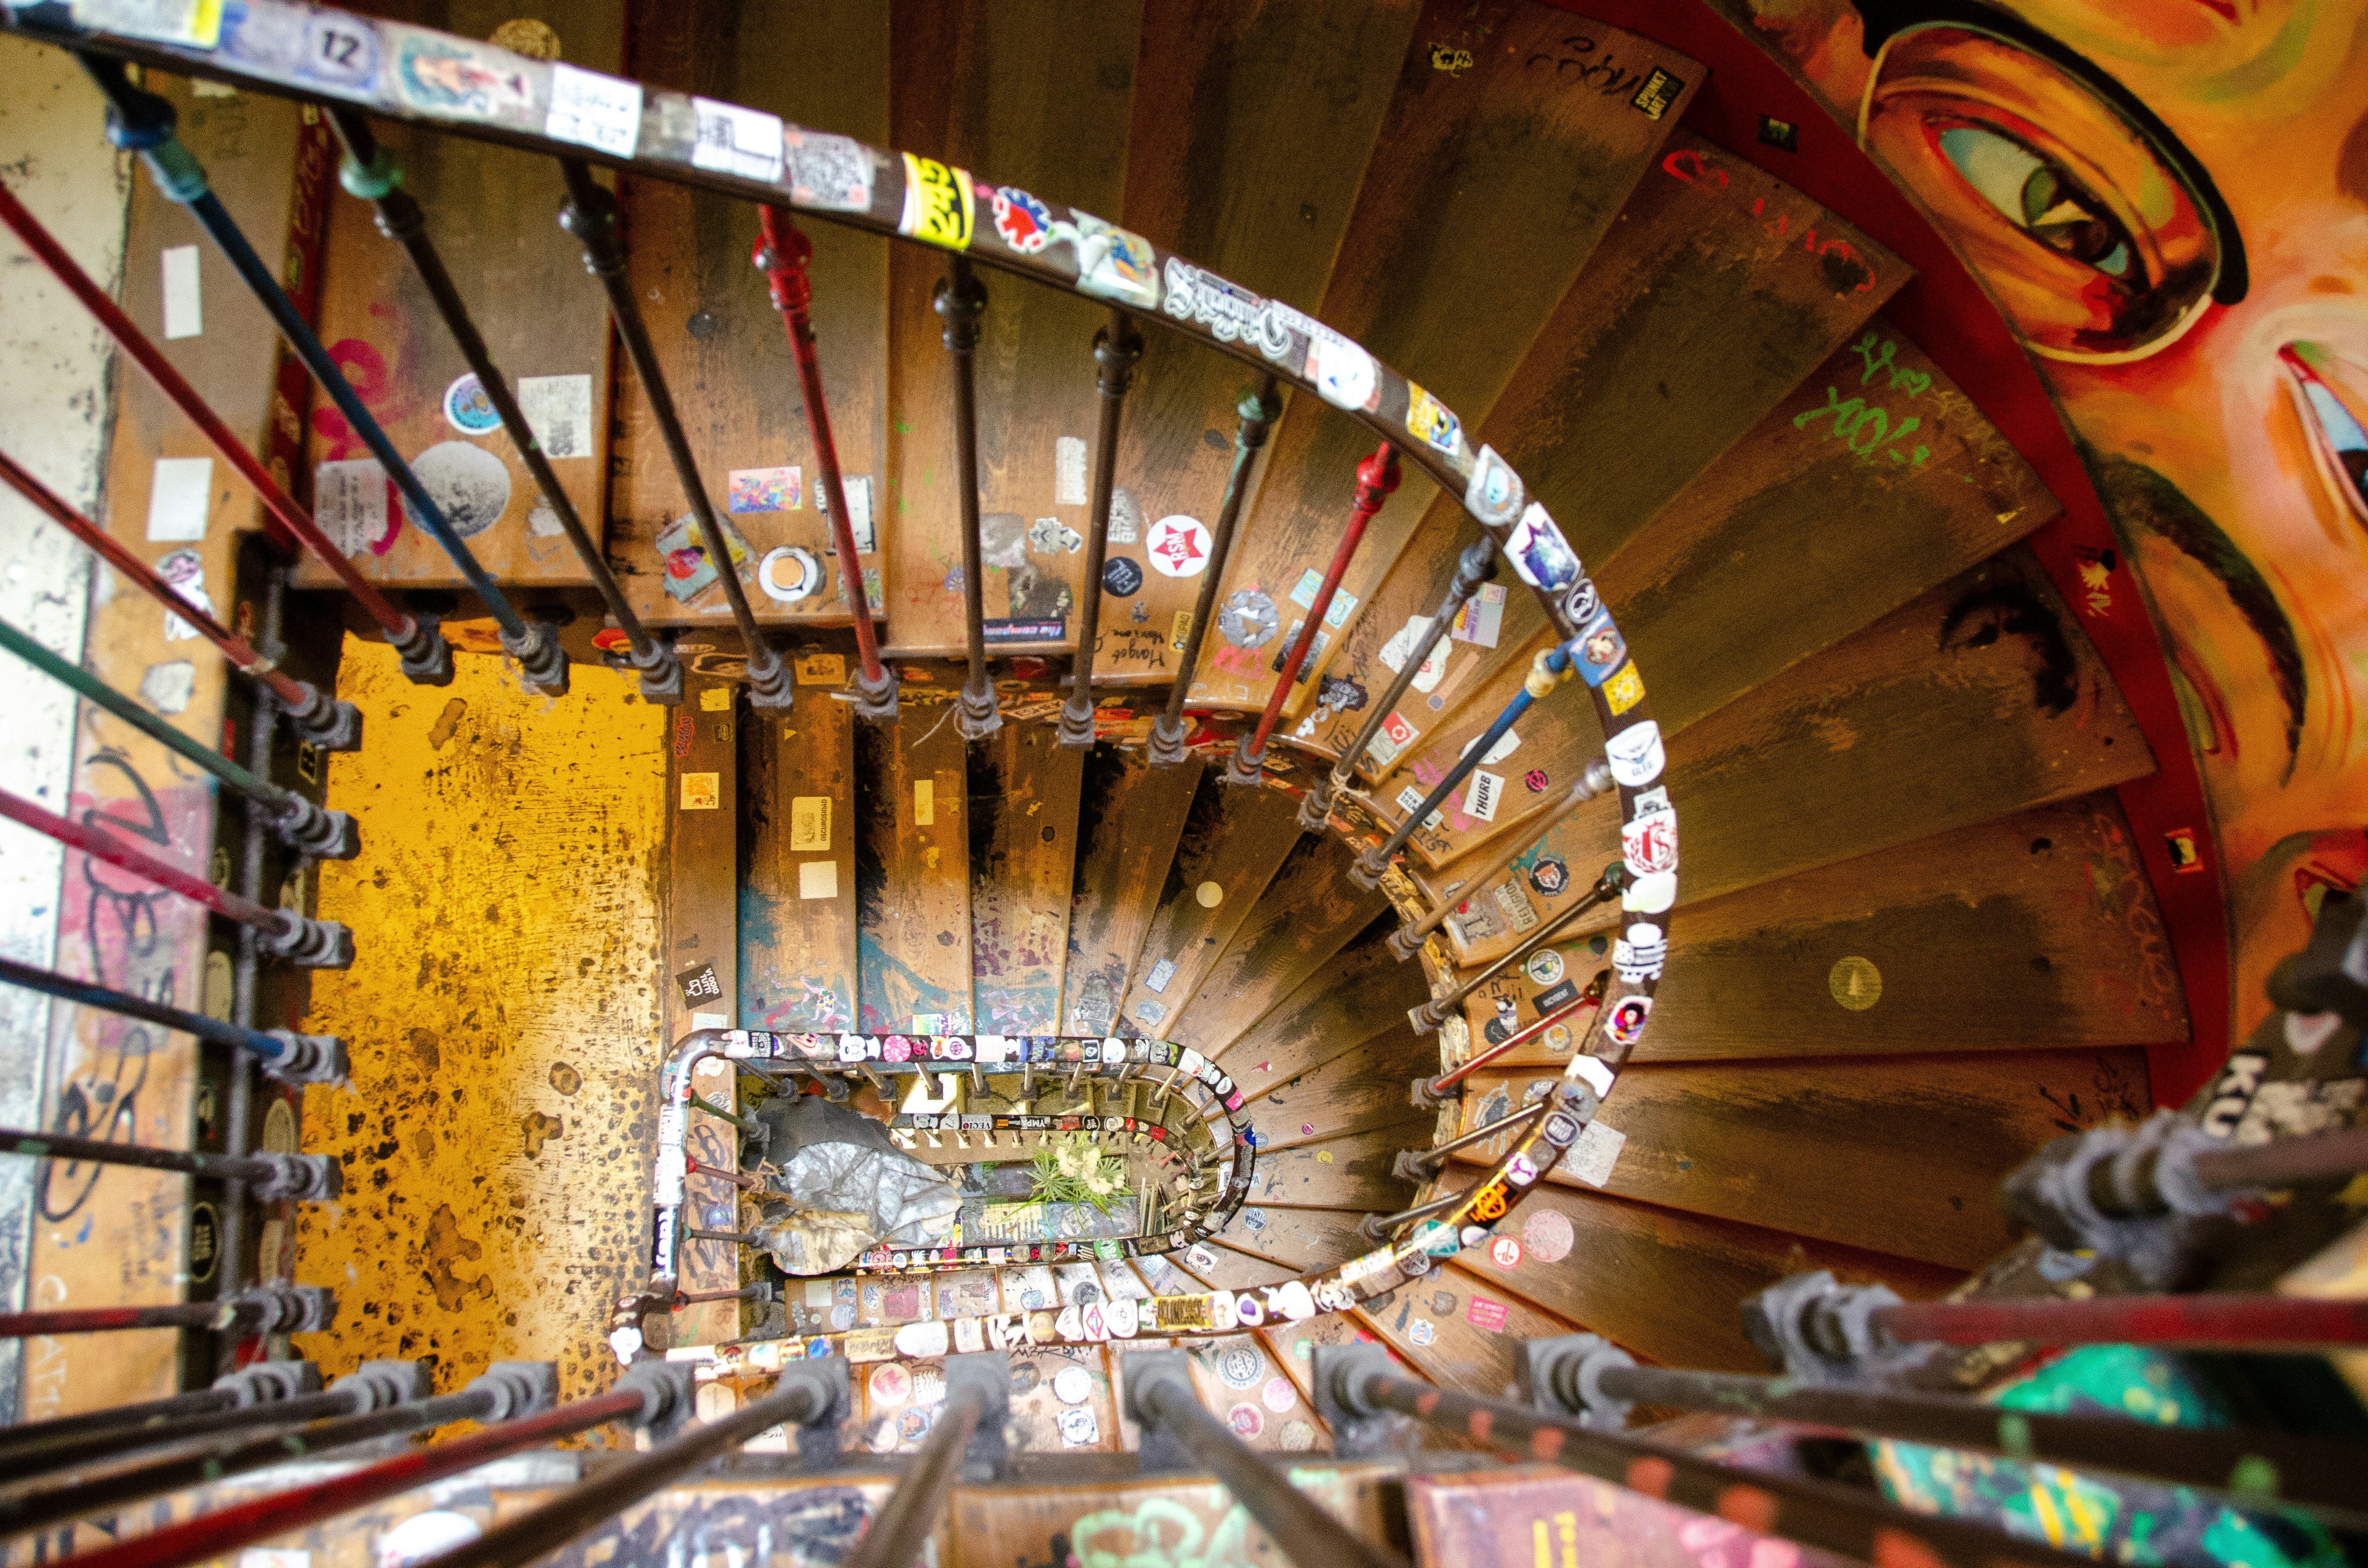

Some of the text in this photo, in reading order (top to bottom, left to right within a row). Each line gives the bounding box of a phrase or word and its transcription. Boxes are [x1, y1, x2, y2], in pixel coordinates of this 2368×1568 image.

[322, 29, 360, 68] 12
[1635, 70, 1667, 109] SPUNKT
[1169, 531, 1185, 562] RSM
[1038, 621, 1063, 638] the
[1475, 773, 1492, 816] THURB
[700, 973, 712, 995] TUTTI
[704, 967, 720, 995] VI ODIO
[1541, 988, 1569, 1008] INCYDENT
